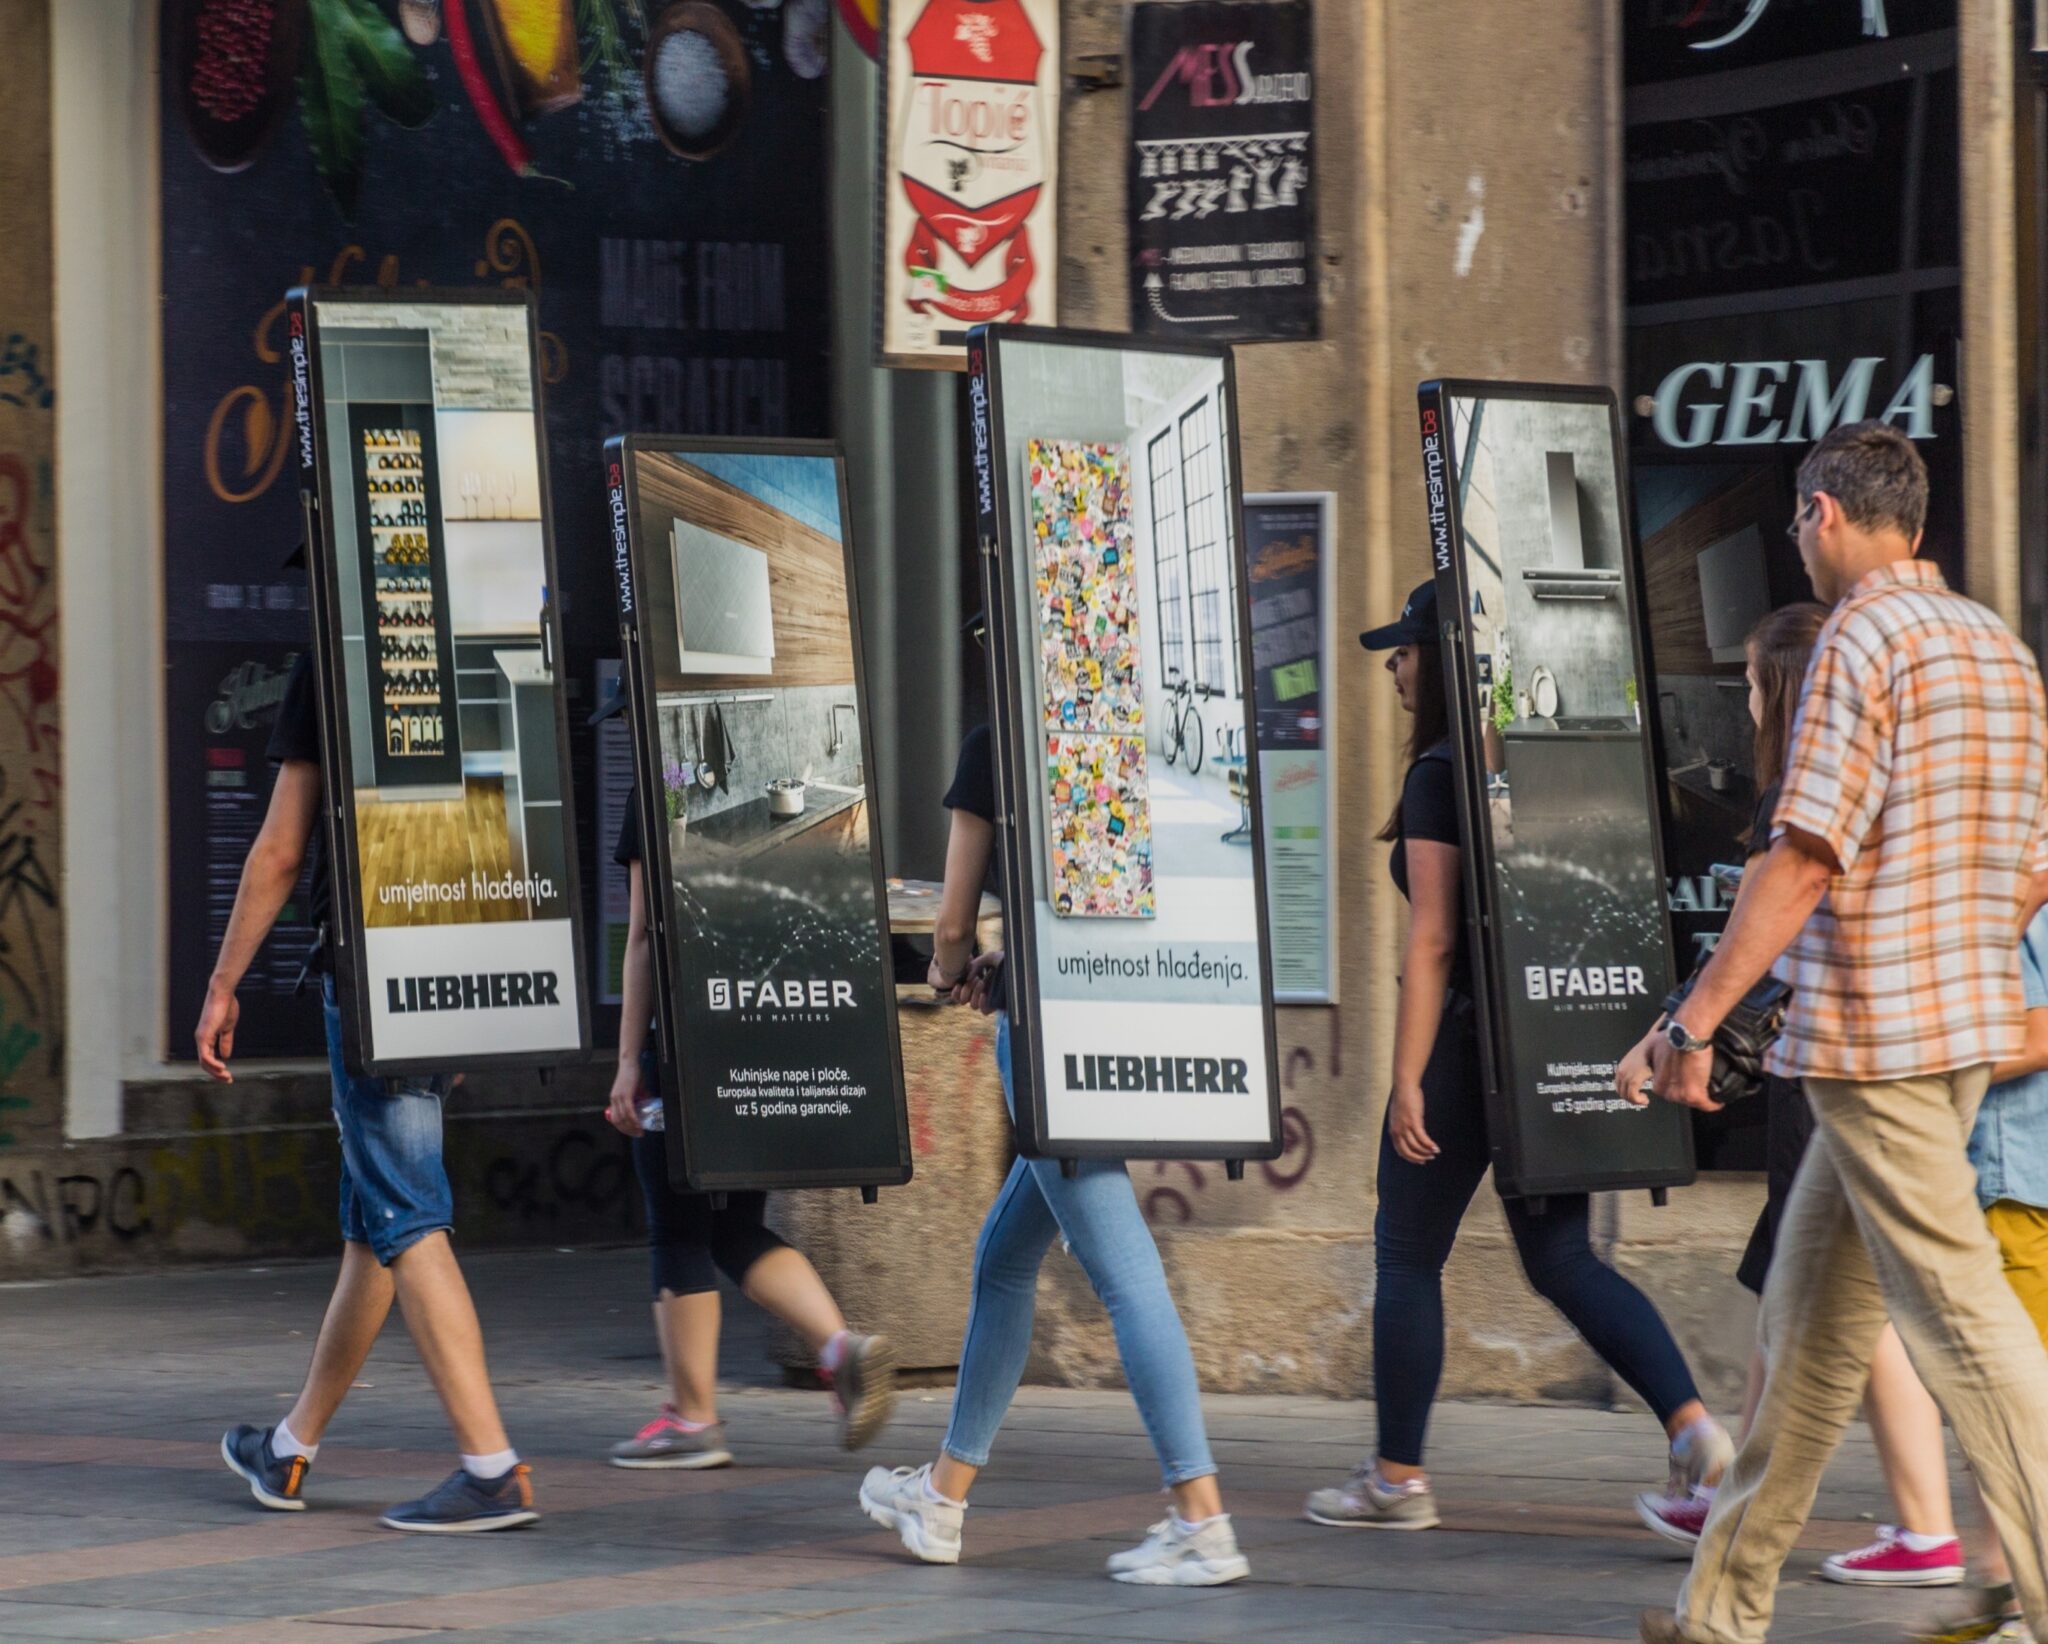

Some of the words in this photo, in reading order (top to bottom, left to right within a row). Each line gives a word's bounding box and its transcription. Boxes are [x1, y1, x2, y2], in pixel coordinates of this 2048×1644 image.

[289, 311, 313, 468] www.thesimple.ba
[1652, 353, 1938, 448] GEMA
[970, 349, 993, 515] www.thesimple.ba
[1423, 409, 1451, 571] www.thesimple.ba
[607, 463, 633, 613] www.thesimple.ba
[379, 878, 466, 912] umjetnost
[471, 869, 558, 907] hlađenja.
[1057, 950, 1150, 984] umjetnost
[1156, 948, 1249, 988] hlađenja.
[1548, 966, 1649, 997] FABER
[386, 970, 560, 1014] LIEBHERR
[737, 980, 858, 1008] FABER
[741, 1014, 762, 1022] AIR
[772, 1014, 830, 1022] MATTERS
[717, 1086, 757, 1100] Europska
[758, 1085, 795, 1097] kvaliteta
[796, 1086, 800, 1096] i
[801, 1085, 838, 1098] talijanski
[840, 1084, 867, 1098] dizajn
[729, 1068, 780, 1084] Kuhinjske
[783, 1070, 809, 1083] nape
[811, 1068, 815, 1081] i
[818, 1067, 851, 1083] ploče.
[1064, 1054, 1250, 1094] LIEBHERR
[735, 1104, 748, 1116] uz
[751, 1101, 758, 1114] 5
[761, 1101, 798, 1117] godina
[800, 1100, 851, 1117] garancije.
